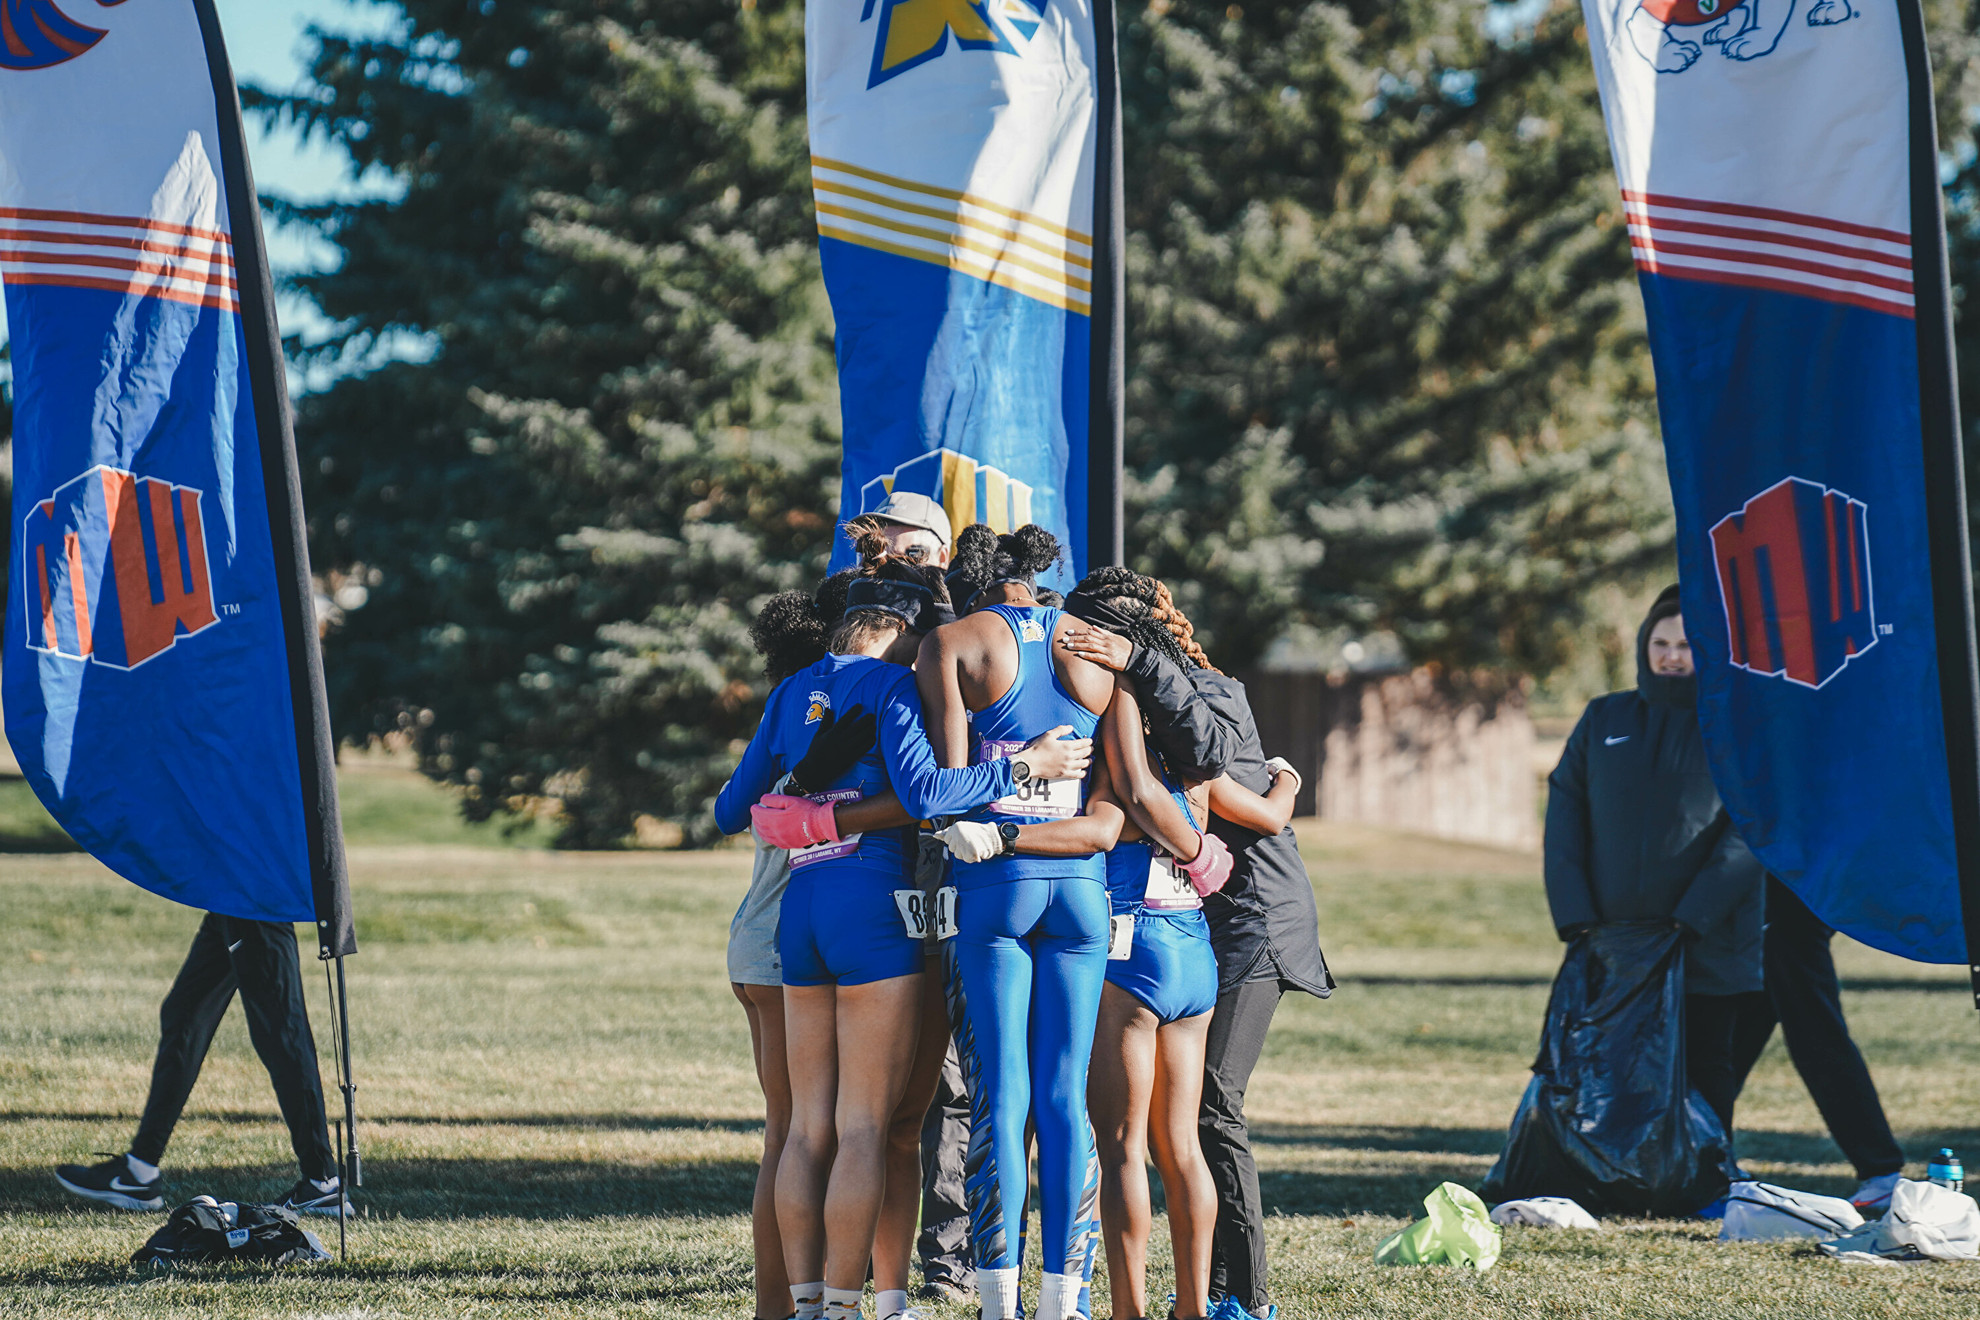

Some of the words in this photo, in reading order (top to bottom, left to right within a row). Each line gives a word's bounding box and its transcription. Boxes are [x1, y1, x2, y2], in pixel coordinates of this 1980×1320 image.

[222, 603, 241, 615] TM
[1878, 623, 1894, 635] TM
[810, 794, 826, 803] OSS
[826, 790, 859, 802] COUNTRY
